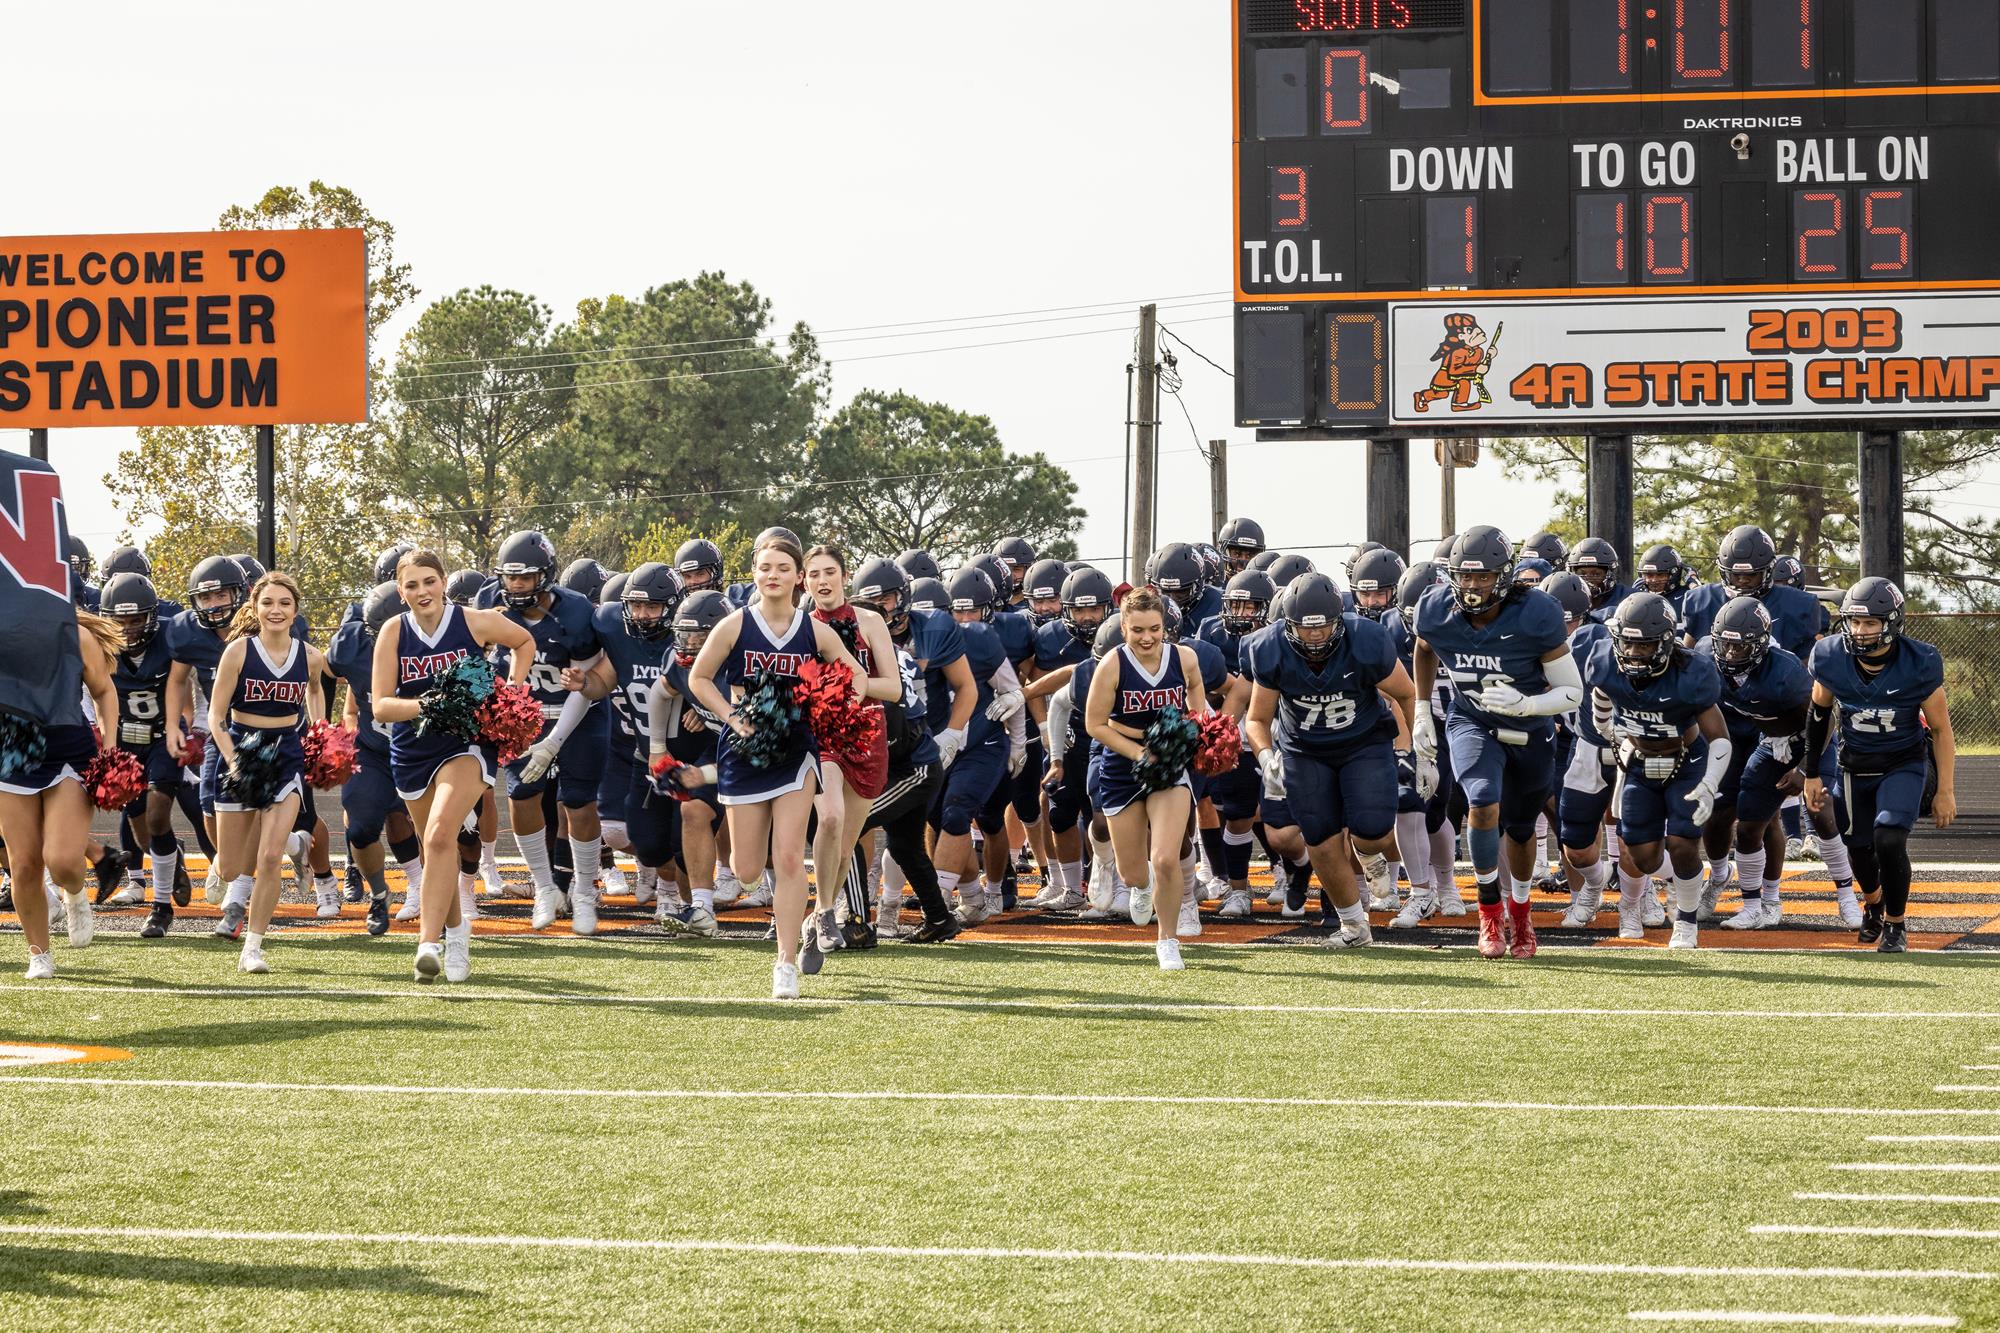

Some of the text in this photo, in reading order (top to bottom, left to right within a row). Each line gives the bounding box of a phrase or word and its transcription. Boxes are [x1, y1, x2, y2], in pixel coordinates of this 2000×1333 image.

[1324, 50, 1367, 128] 0
[1683, 116, 1803, 130] DAKTRONICS
[1388, 146, 1514, 192] DOWN
[1572, 141, 1696, 189] TO GO
[1775, 136, 1930, 184] BALL ON
[1278, 167, 1307, 226] 3
[1464, 205, 1474, 274] 1
[1615, 196, 1690, 276] 10
[1798, 191, 1909, 273] 25
[228, 248, 286, 283] TO
[1243, 238, 1343, 285] T.O.L.
[0, 294, 276, 350] PIONEER
[1241, 304, 1290, 313] DAKTRONICS
[1746, 307, 1903, 356] 2003
[0, 357, 279, 412] STADIUM
[1329, 313, 1383, 411] 0
[1509, 356, 2000, 410] 4A STATE CHAMP
[632, 664, 662, 679] LYO
[1454, 653, 1503, 672] LYON
[127, 690, 161, 719] 8
[244, 678, 307, 705] LYON
[1122, 685, 1183, 714] LYON
[1292, 698, 1357, 731] 78
[1620, 706, 1665, 724] LYON
